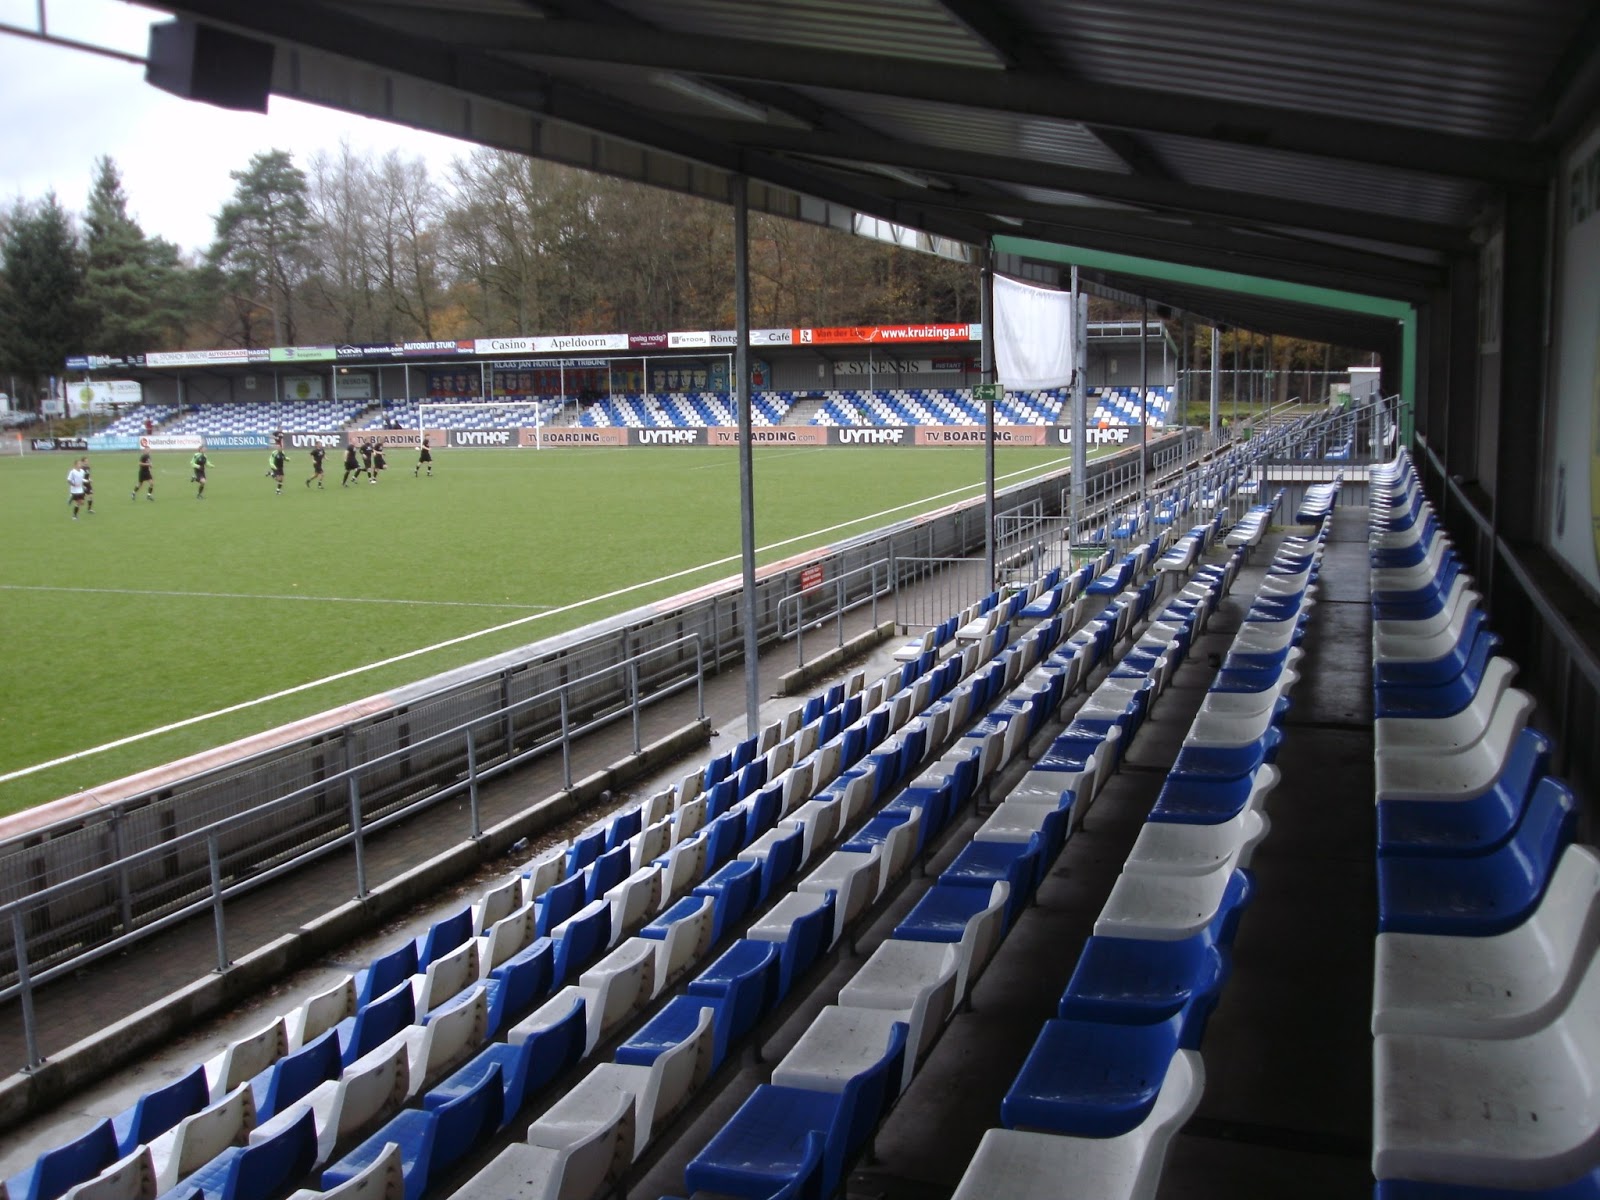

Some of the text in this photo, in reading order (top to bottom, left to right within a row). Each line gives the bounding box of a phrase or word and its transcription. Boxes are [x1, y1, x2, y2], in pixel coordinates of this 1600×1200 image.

[768, 332, 790, 341] Café
[816, 329, 832, 337] Van
[833, 328, 848, 336] der
[881, 325, 969, 339] www.kruizinga.nl
[648, 334, 667, 342] nodig?
[404, 341, 434, 350] AUTORUIT
[491, 340, 526, 350] Casino
[550, 338, 607, 348] Apeldoorn
[518, 361, 531, 369] JAN
[849, 361, 919, 374] SYNENSIS
[206, 437, 268, 446] WWW.DESKO.NL
[292, 434, 340, 447] UYTHOF
[456, 431, 510, 445] UYTHOF
[638, 430, 698, 444] UYTHOF
[717, 432, 816, 441] TV BARDING.com
[839, 429, 904, 443] UYTHOF
[925, 431, 1033, 441] TV BOARDNG.com
[1058, 428, 1130, 444] UTHOF
